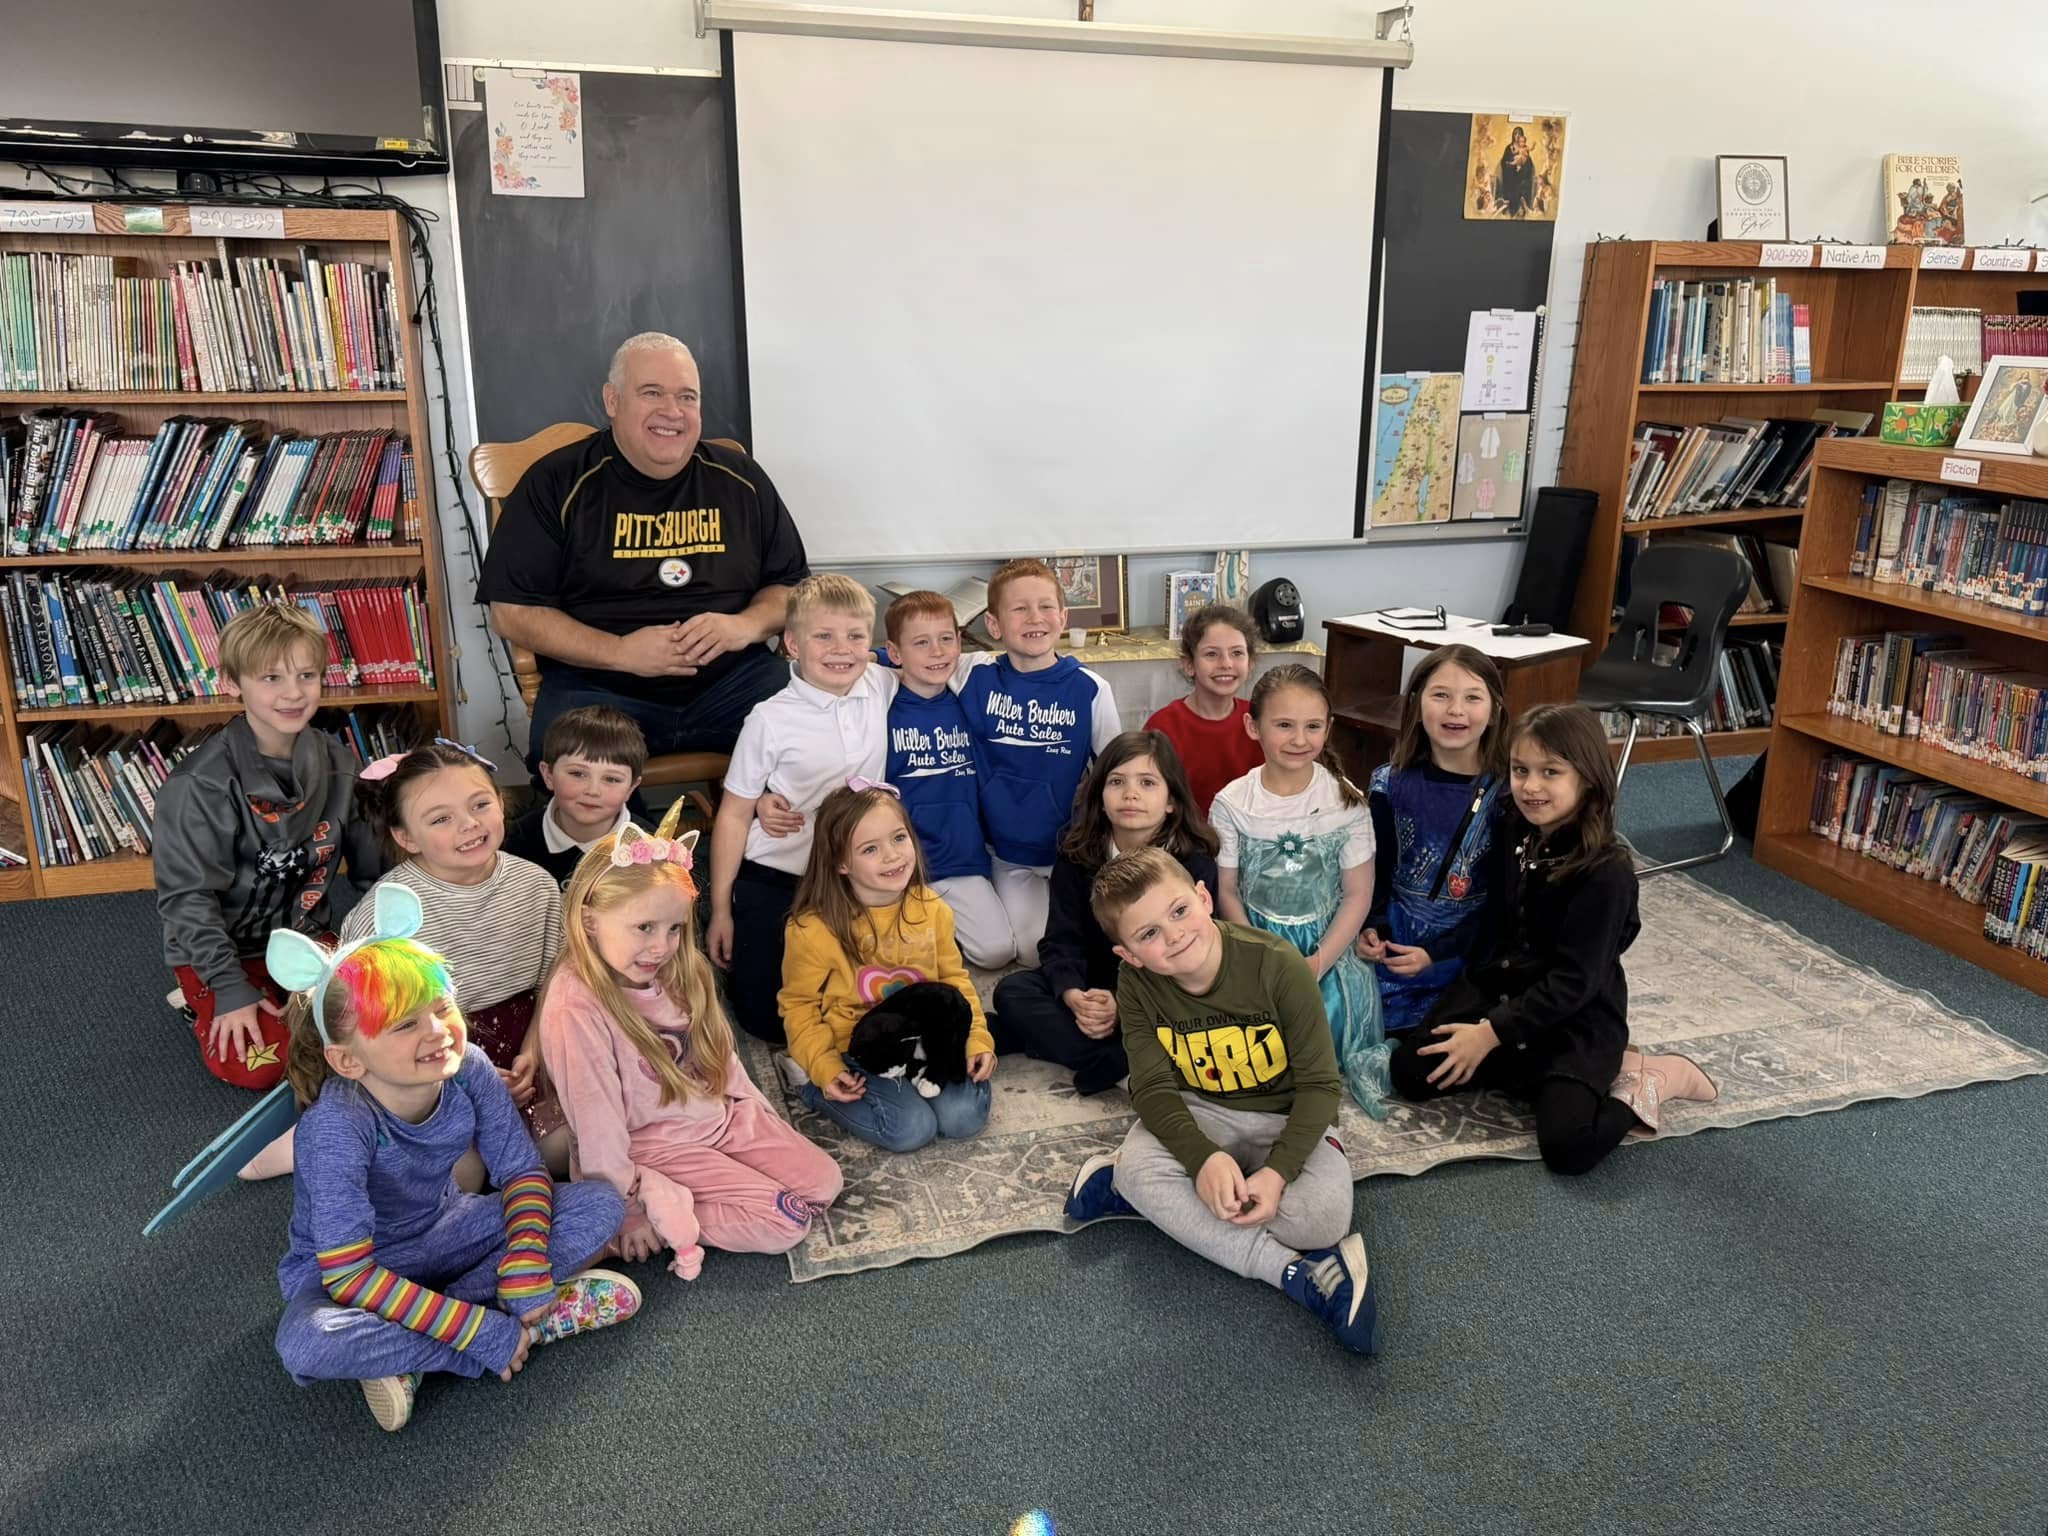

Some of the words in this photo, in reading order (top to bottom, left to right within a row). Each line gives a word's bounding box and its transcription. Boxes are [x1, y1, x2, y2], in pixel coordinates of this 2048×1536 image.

[1896, 164, 1913, 173] FOR
[1914, 165, 1960, 174] CHILDREN
[1897, 155, 1920, 164] BIBLE
[1921, 156, 1958, 165] STORIES
[4, 209, 86, 229] 700-799
[1765, 248, 1809, 263] 900-999
[1826, 249, 1859, 264] Native
[1861, 249, 1880, 264] Am
[1926, 251, 1959, 265] Series
[32, 423, 43, 443] The
[25, 444, 41, 485] Football
[1945, 462, 1978, 476] Fiction
[21, 486, 34, 512] Book
[614, 508, 721, 547] PITTSBURGH
[34, 621, 56, 680] SEASONS
[87, 624, 105, 660] Football
[986, 690, 1023, 720] Miller
[1027, 699, 1076, 726] Brothers
[892, 727, 932, 754] Miller
[933, 724, 971, 751] Brother
[995, 719, 1025, 736] Auto
[1029, 724, 1063, 740] Sales
[907, 752, 937, 767] Auto
[940, 749, 966, 765] Sales
[1172, 1017, 1203, 1032] YOUR
[1206, 1012, 1237, 1026] OWN
[1156, 1023, 1288, 1092] HERO
